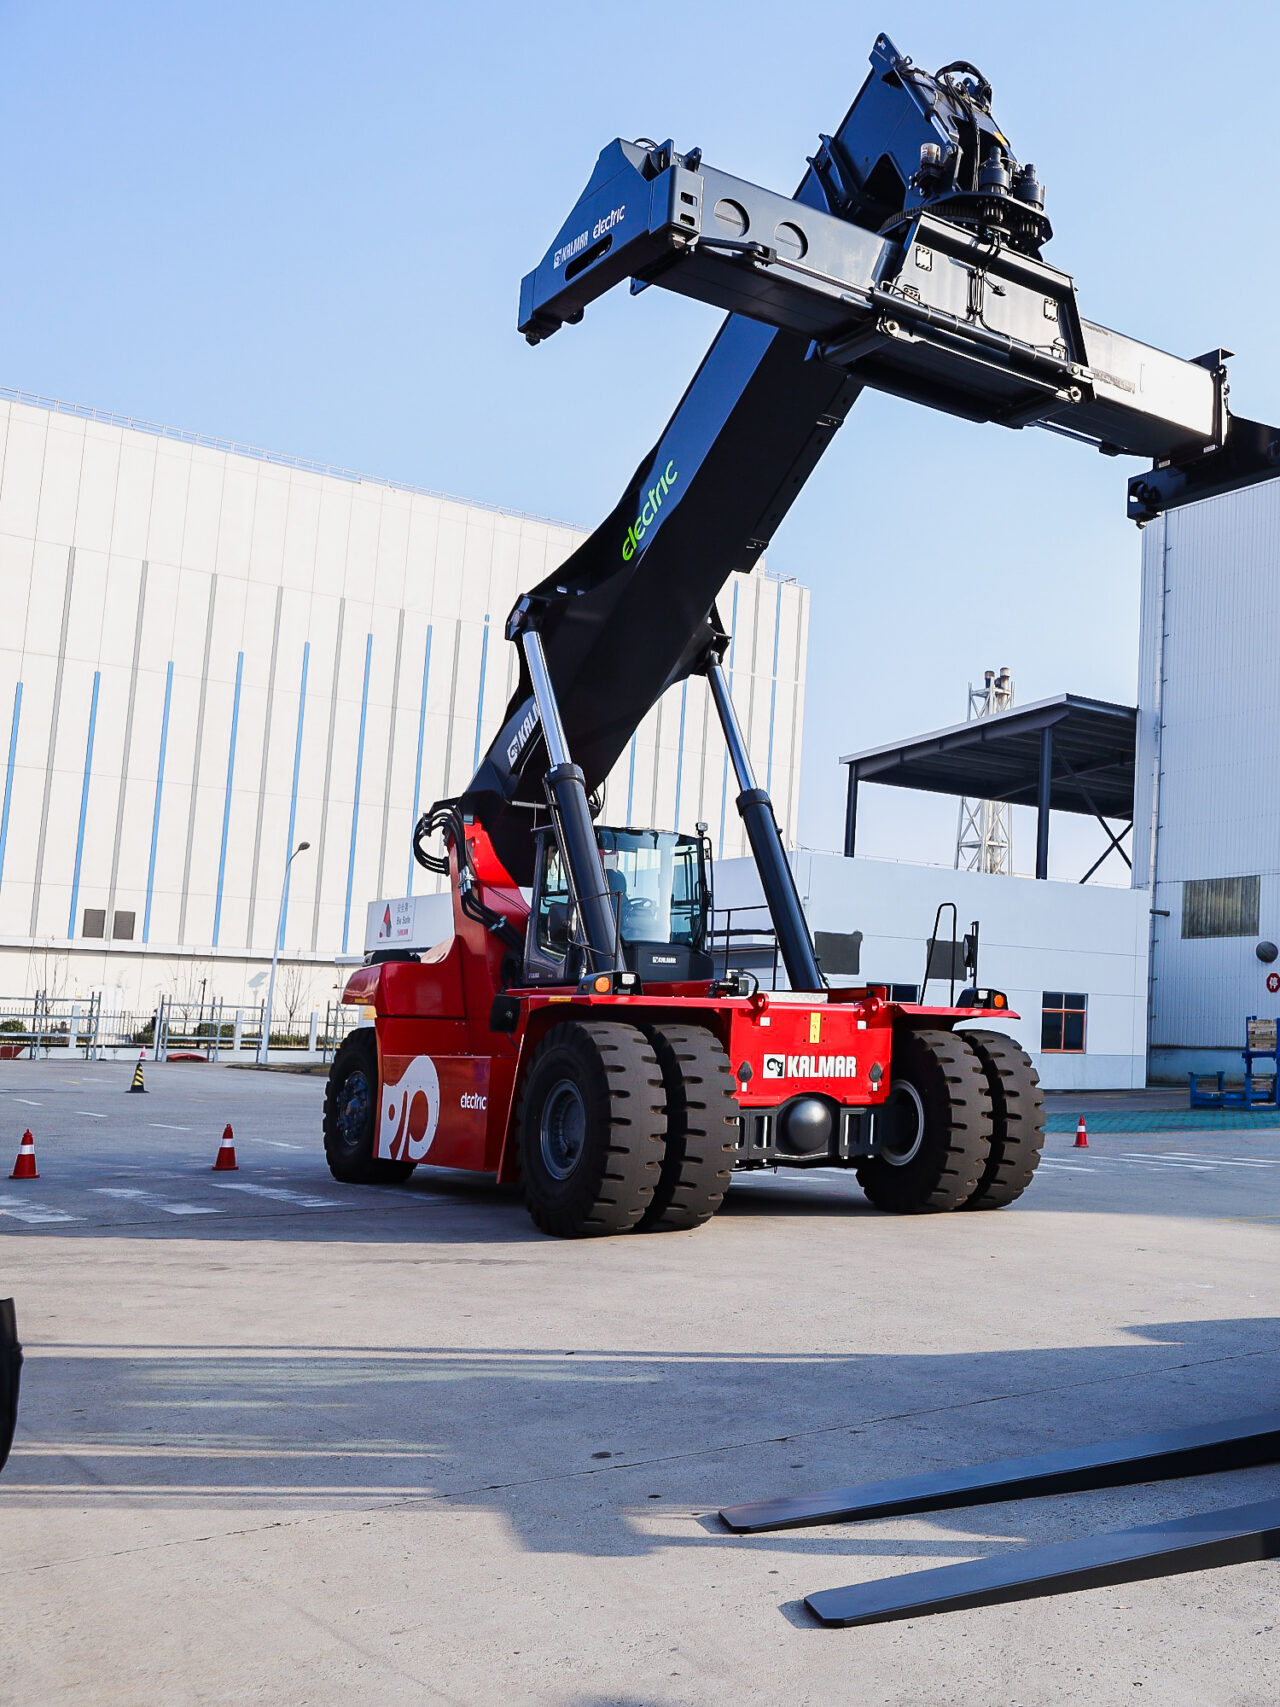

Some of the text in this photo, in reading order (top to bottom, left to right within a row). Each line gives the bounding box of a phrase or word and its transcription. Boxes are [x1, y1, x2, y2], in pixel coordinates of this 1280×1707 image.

[562, 205, 626, 263] KALMAR electric
[622, 459, 679, 561] electric
[787, 1055, 857, 1078] KALMAR
[460, 1091, 487, 1110] electric
